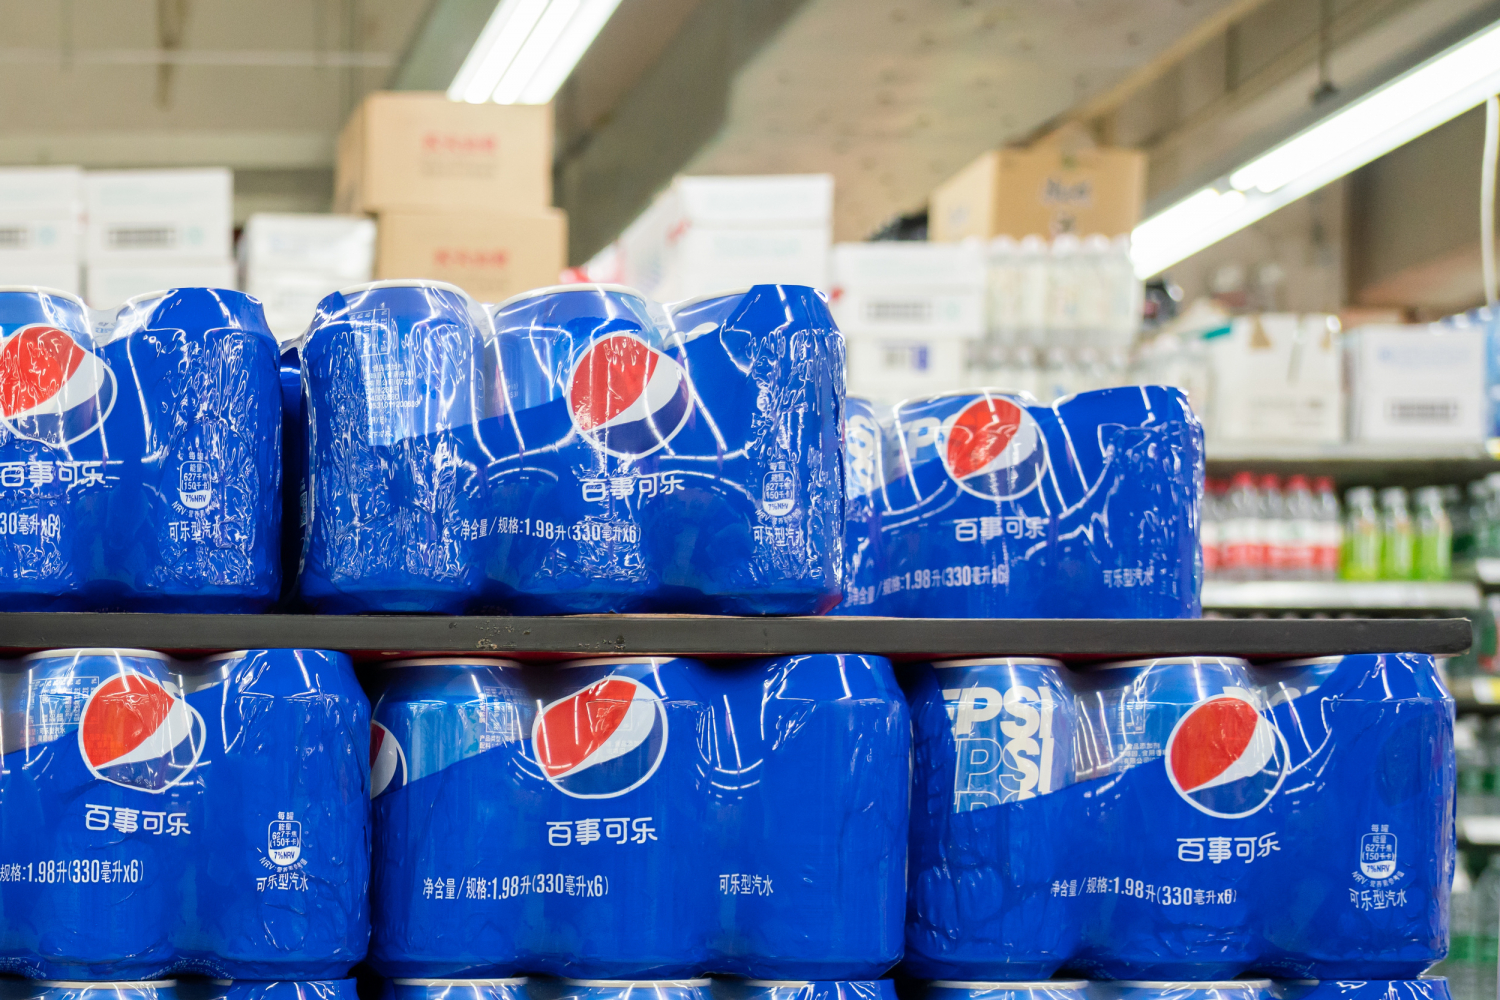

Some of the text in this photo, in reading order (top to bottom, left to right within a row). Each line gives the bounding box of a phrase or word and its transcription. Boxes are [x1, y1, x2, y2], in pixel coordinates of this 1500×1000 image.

[1, 460, 108, 488] 百事可乐
[581, 475, 684, 502] 百事可乐
[953, 516, 1046, 542] 百事可乐
[84, 804, 191, 834] 百事可乐
[546, 817, 658, 846] 百事可乐
[1177, 832, 1281, 864] 百事可乐
[256, 872, 309, 893] 可乐型汽水
[719, 873, 773, 896] 可乐型汽水
[1350, 888, 1406, 910] 可乐型汽水
